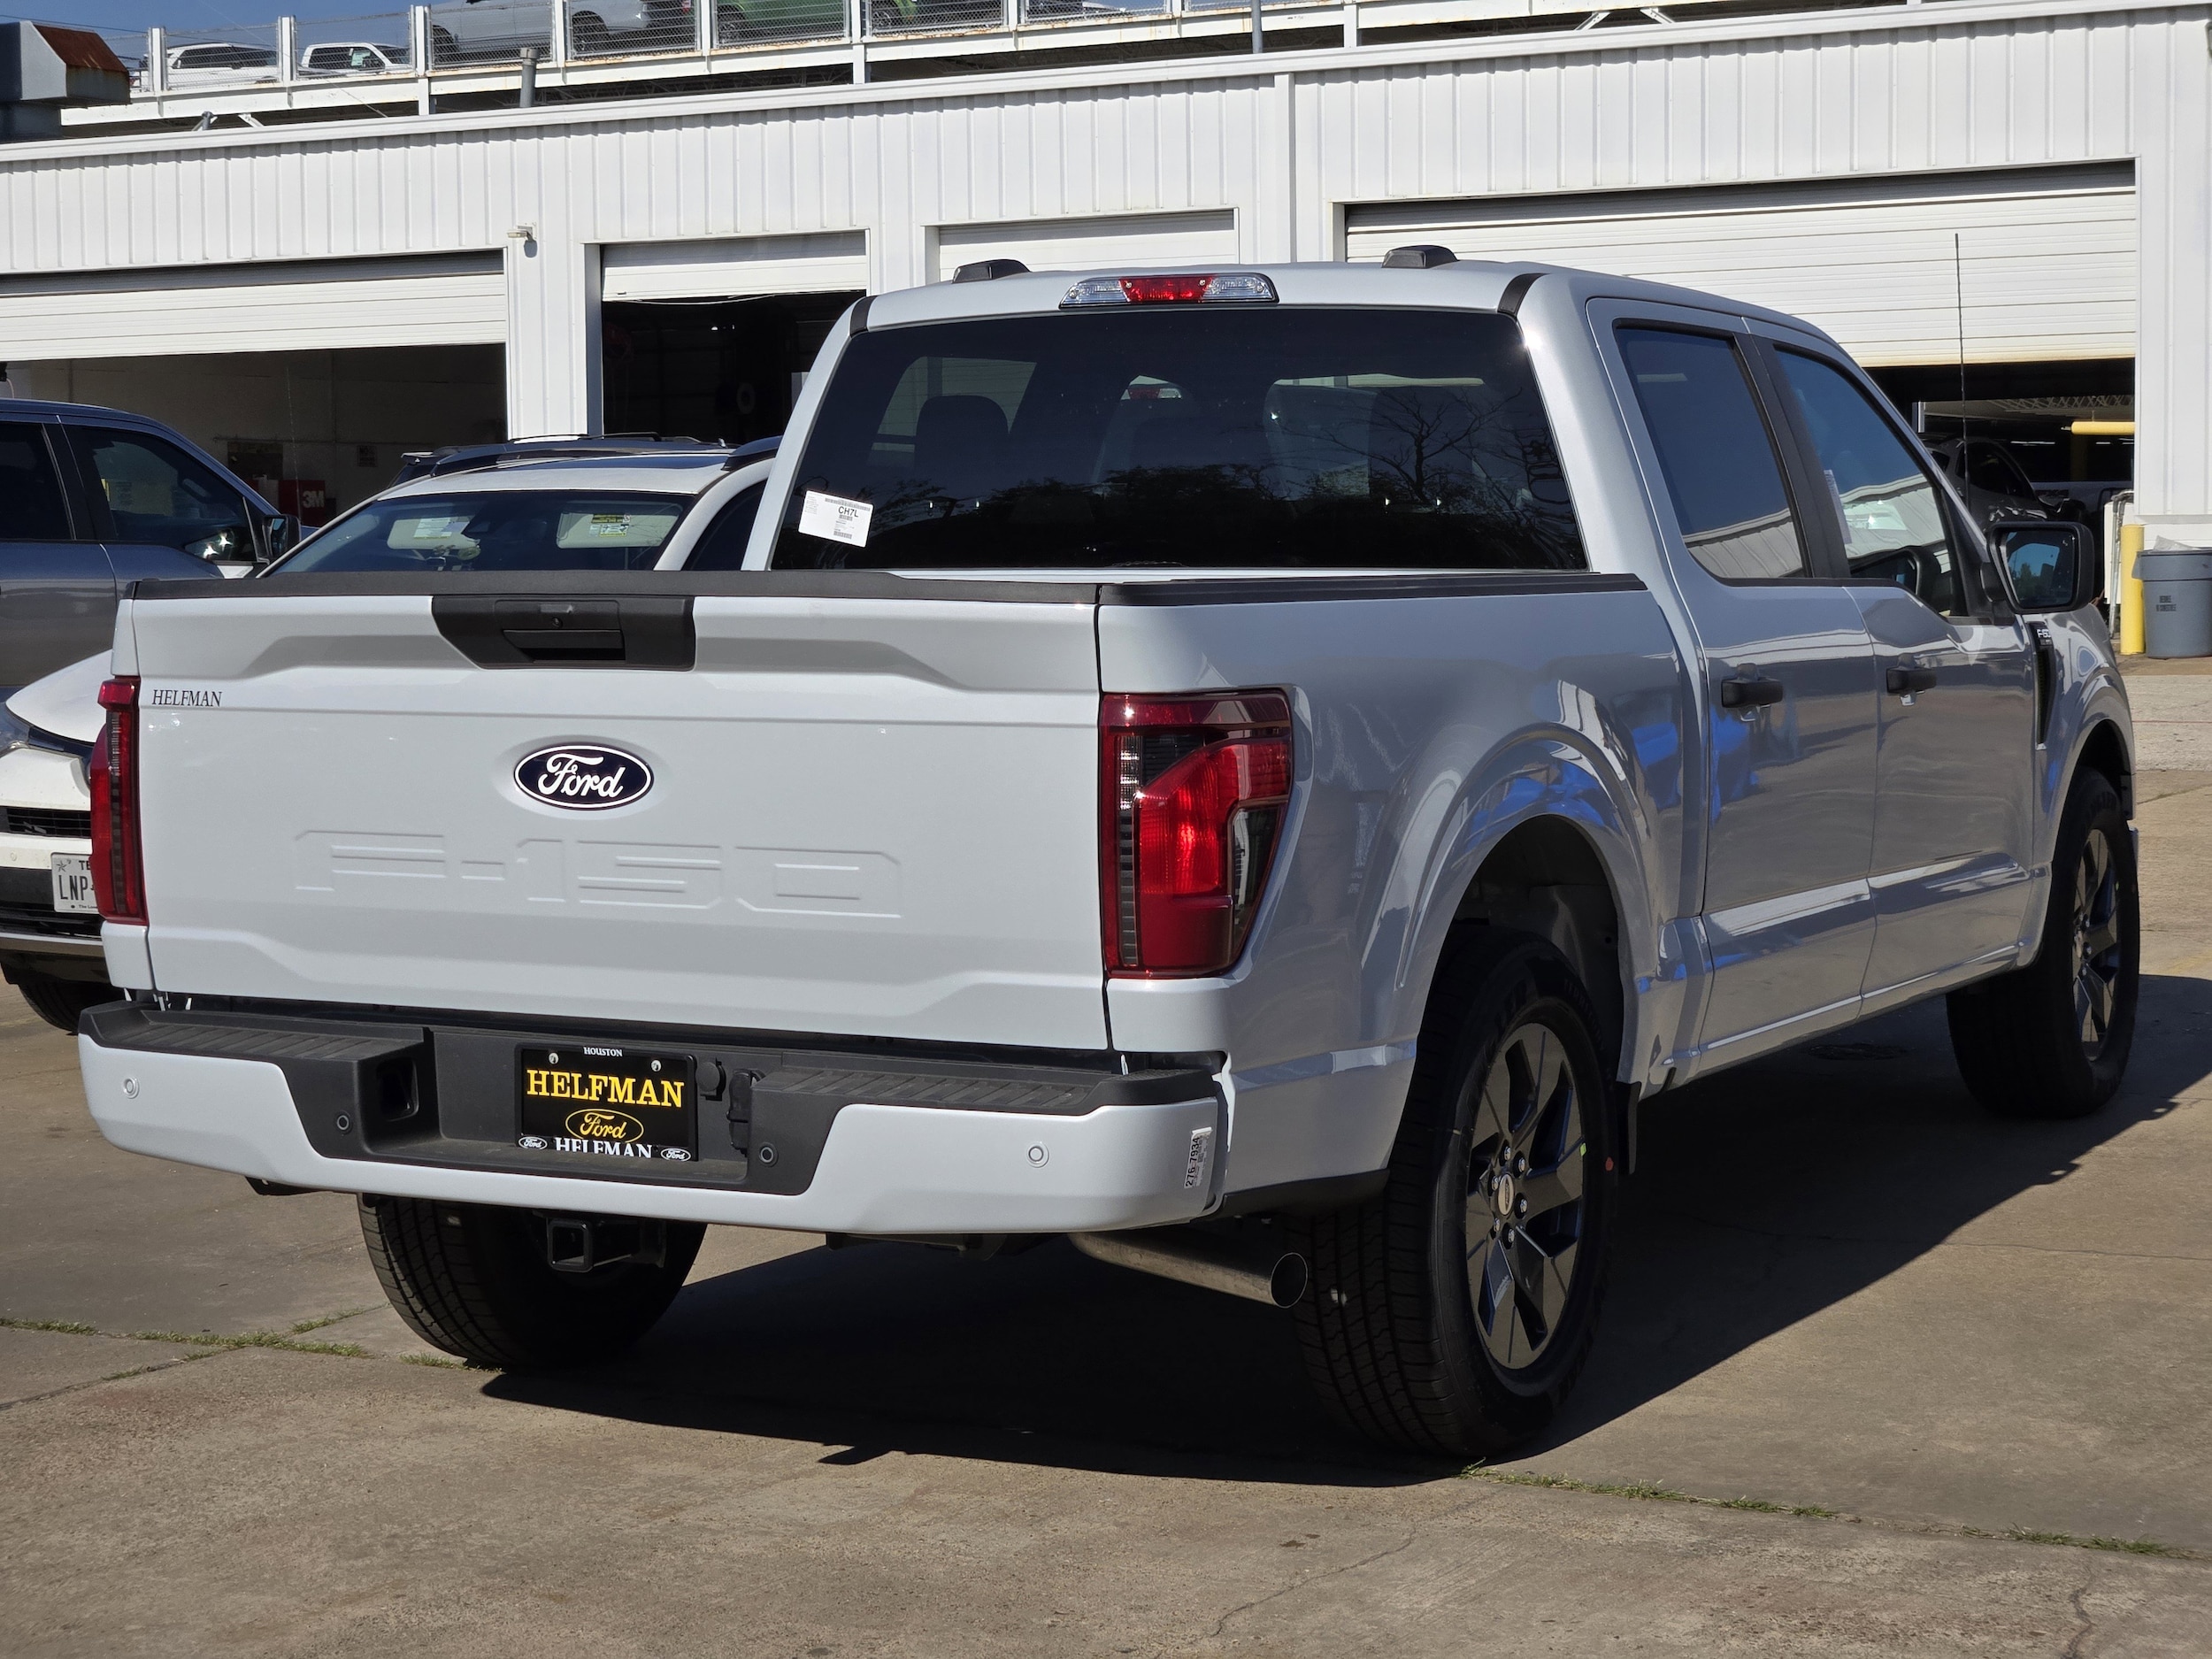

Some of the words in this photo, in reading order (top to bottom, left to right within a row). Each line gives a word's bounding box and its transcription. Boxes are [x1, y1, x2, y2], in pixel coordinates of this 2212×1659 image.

[302, 490, 326, 509] 3M
[838, 506, 859, 518] CH7L
[151, 689, 223, 707] HELFMAN
[537, 753, 626, 797] Ford
[583, 1047, 623, 1057] HOUSTON
[526, 1069, 685, 1108] HELFMAN
[580, 1111, 627, 1140] Ford
